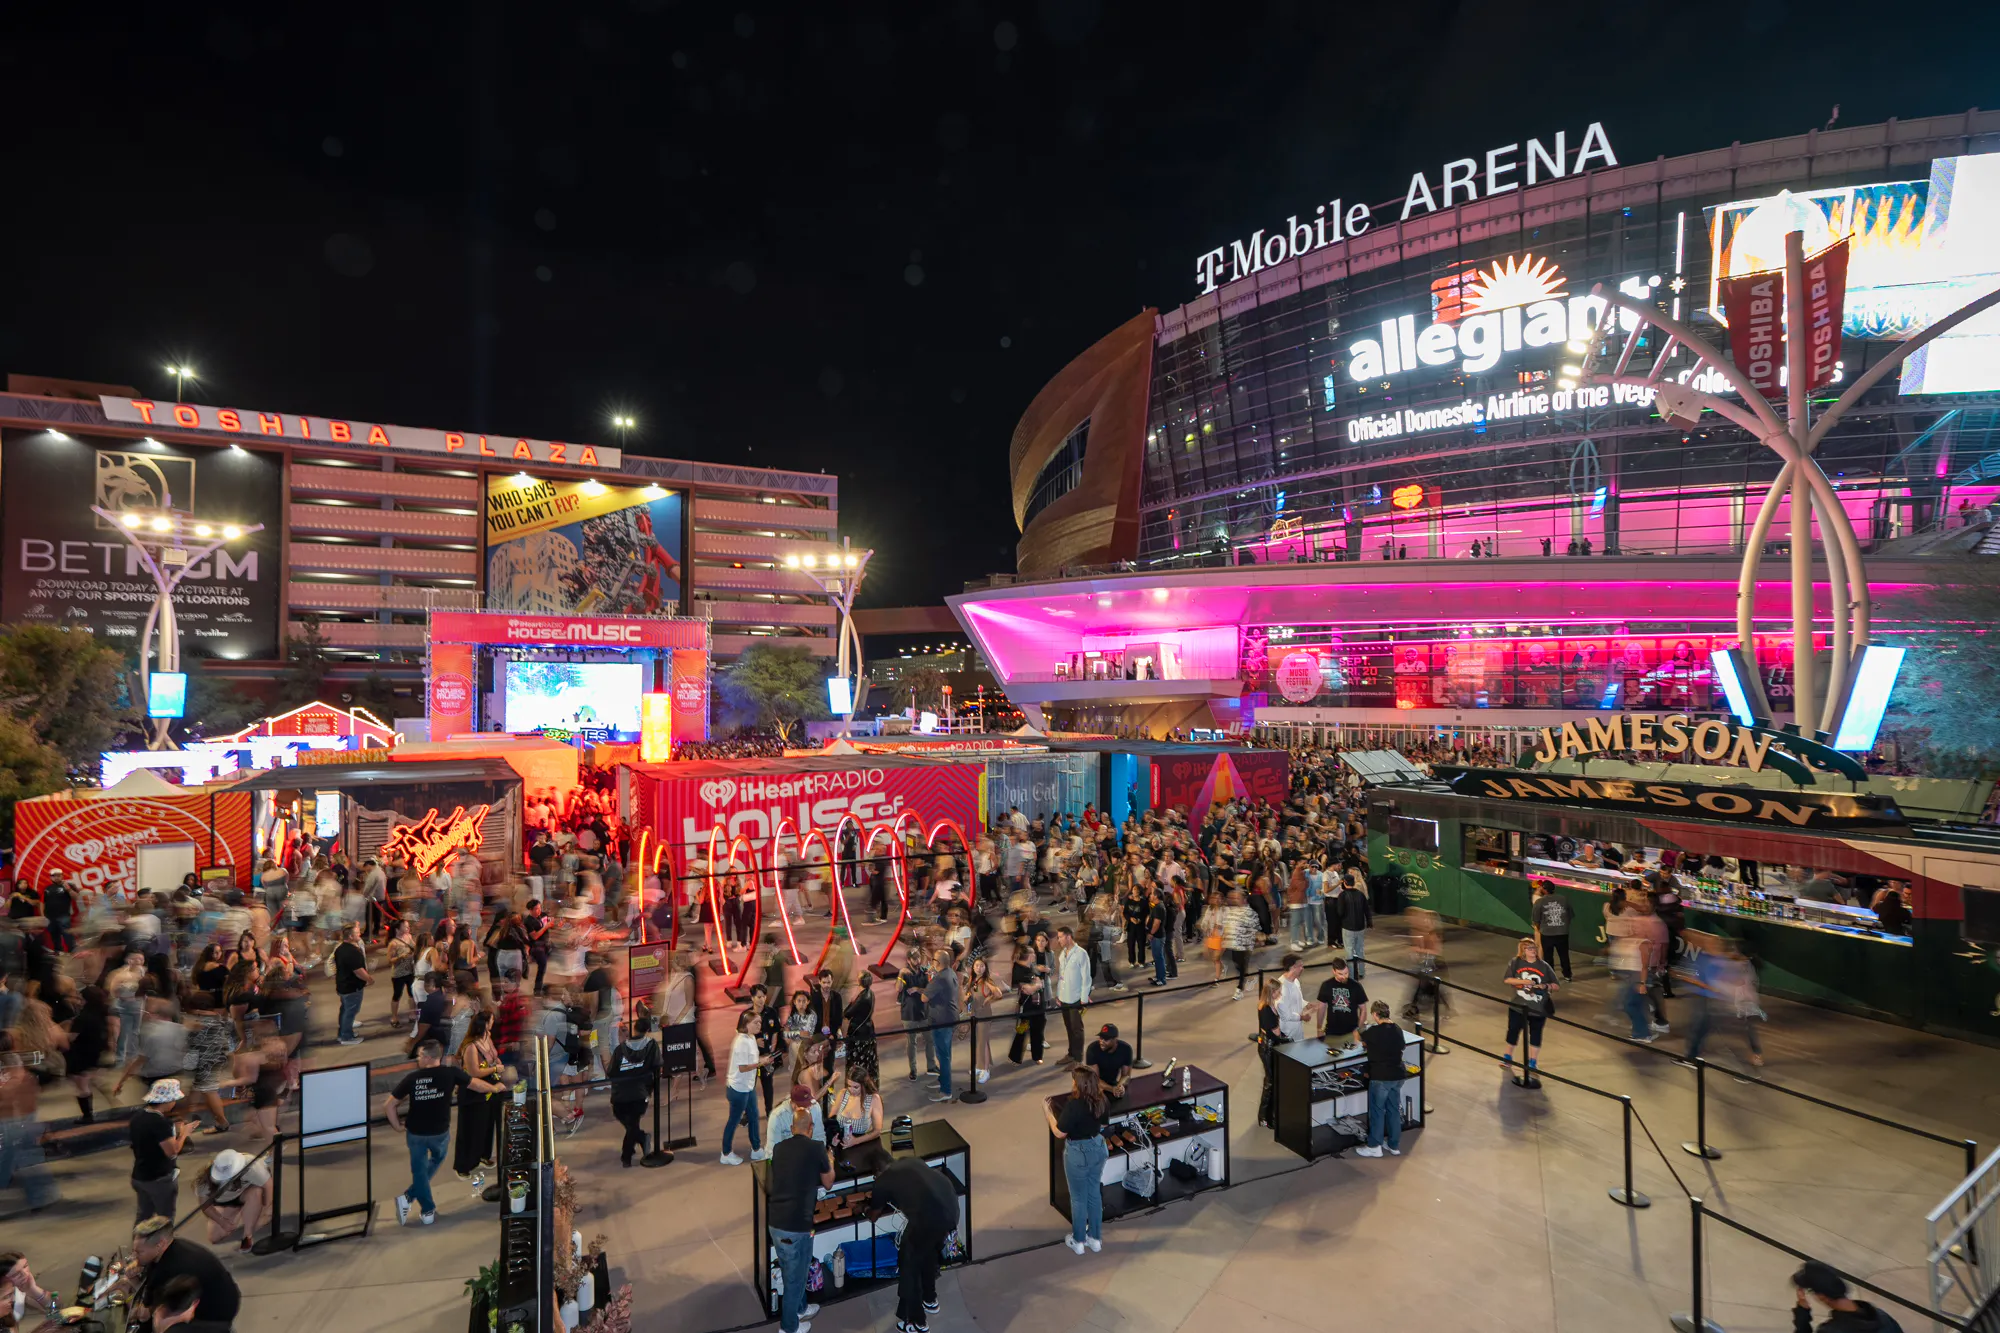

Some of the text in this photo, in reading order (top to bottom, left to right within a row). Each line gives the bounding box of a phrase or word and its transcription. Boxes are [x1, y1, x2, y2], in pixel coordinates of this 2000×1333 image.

[1400, 122, 1618, 220] ARENA
[1749, 280, 1774, 390] TOSHIBA
[1810, 262, 1832, 382] TOSHIBA
[1349, 411, 1402, 443] Official
[1405, 399, 1484, 433] Domestic
[1486, 392, 1549, 421] Airline
[1552, 389, 1577, 411] of
[131, 399, 598, 467] TOSHIBA PLAZA
[488, 480, 557, 512] WHO SAYS
[487, 493, 580, 533] YOU CAN'T FLY?
[29, 588, 54, 599] ANY
[57, 589, 74, 600] OF
[76, 590, 103, 601] OUR
[187, 594, 251, 606] LOCATIONS
[36, 578, 108, 592] DOWNLOAD
[109, 582, 149, 593] TODAY
[177, 584, 228, 597] ACTIVATE
[230, 586, 244, 597] AT
[507, 627, 567, 640] HOUSE
[566, 623, 642, 641] MUSIC
[1289, 668, 1309, 677] MUSIC
[1362, 666, 1379, 677] 20
[1769, 684, 1795, 697] ax
[1535, 714, 1778, 773] JAMESON
[740, 768, 885, 803] iHeartRADIO
[1032, 781, 1059, 802] Cat
[1480, 778, 1826, 826] JAMESON
[47, 806, 167, 842] LAS VEGAS
[104, 826, 159, 848] iHeart
[683, 792, 904, 861] HOUSE
[877, 795, 904, 817] of
[666, 1042, 691, 1052] CHECK IN
[415, 1088, 438, 1096] CAPTURE
